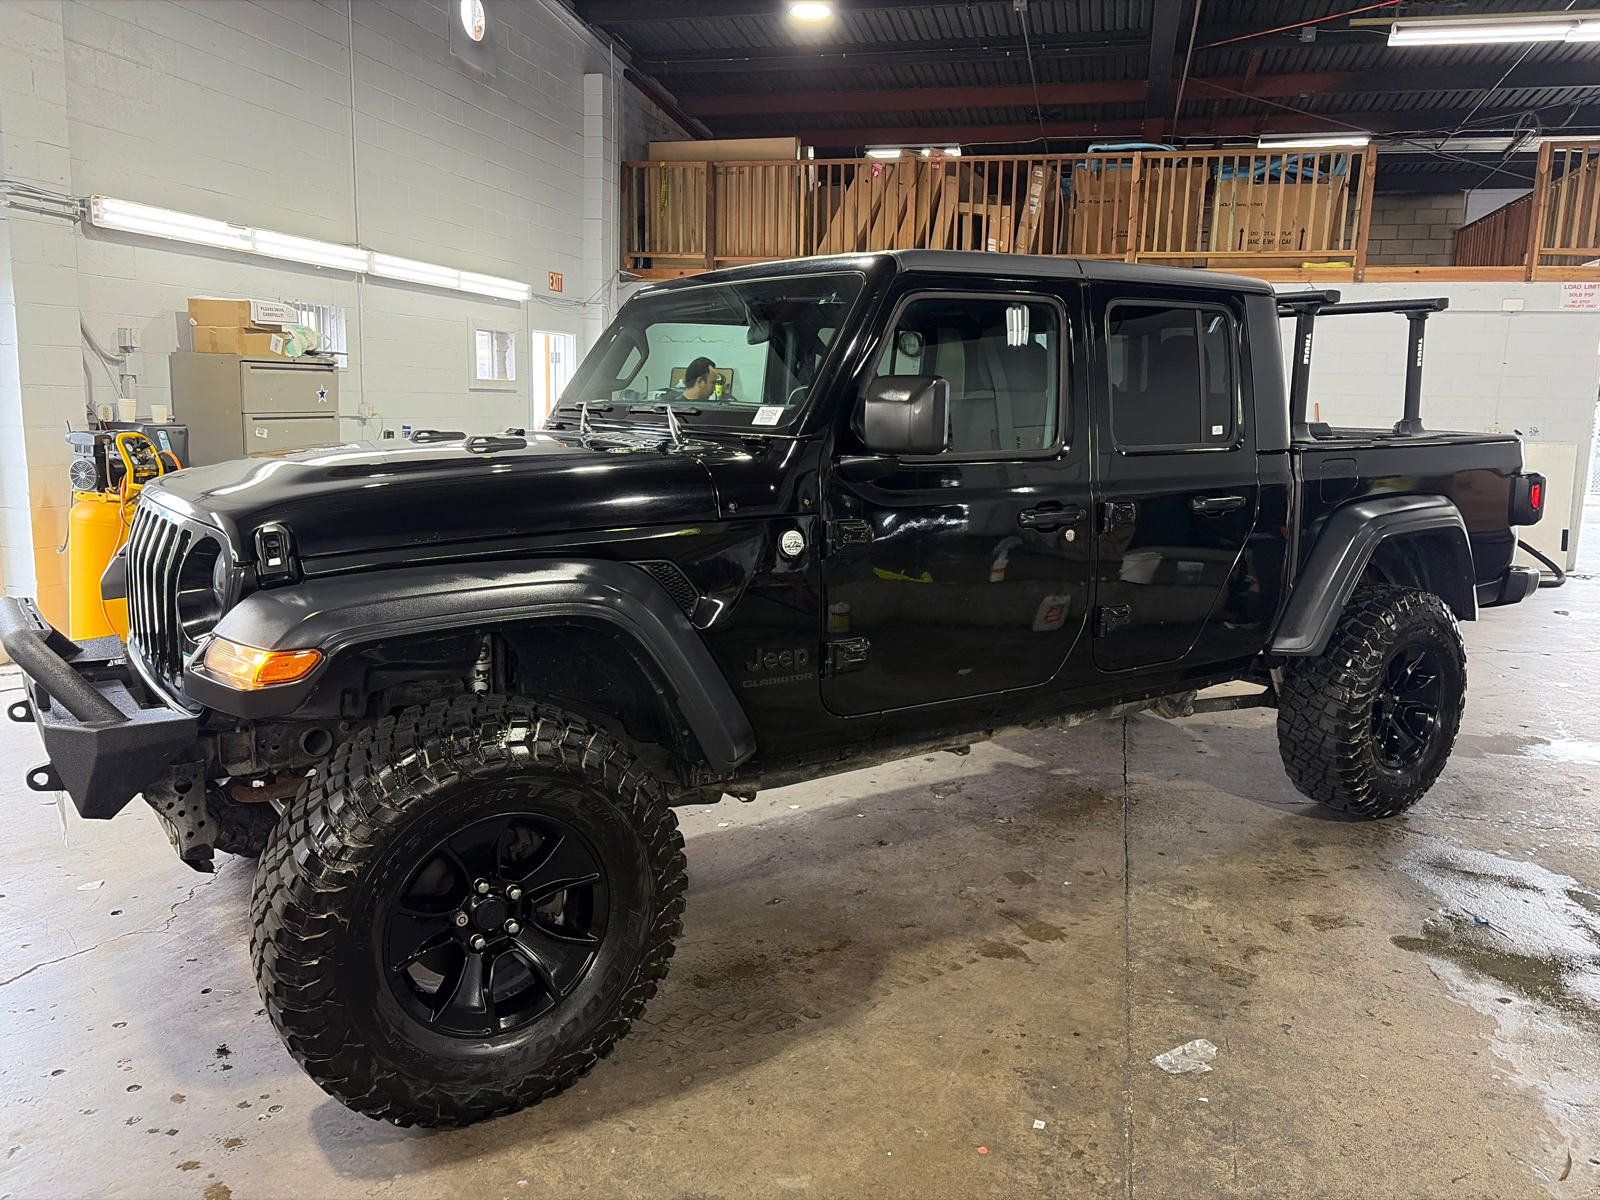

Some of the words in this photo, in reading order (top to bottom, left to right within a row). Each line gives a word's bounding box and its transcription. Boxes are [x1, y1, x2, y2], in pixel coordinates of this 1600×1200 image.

[549, 272, 563, 292] EXIT
[1302, 332, 1312, 365] THULE
[1416, 337, 1424, 367] THULE
[744, 648, 809, 673] Jeep
[742, 672, 813, 688] GLADIATOR
